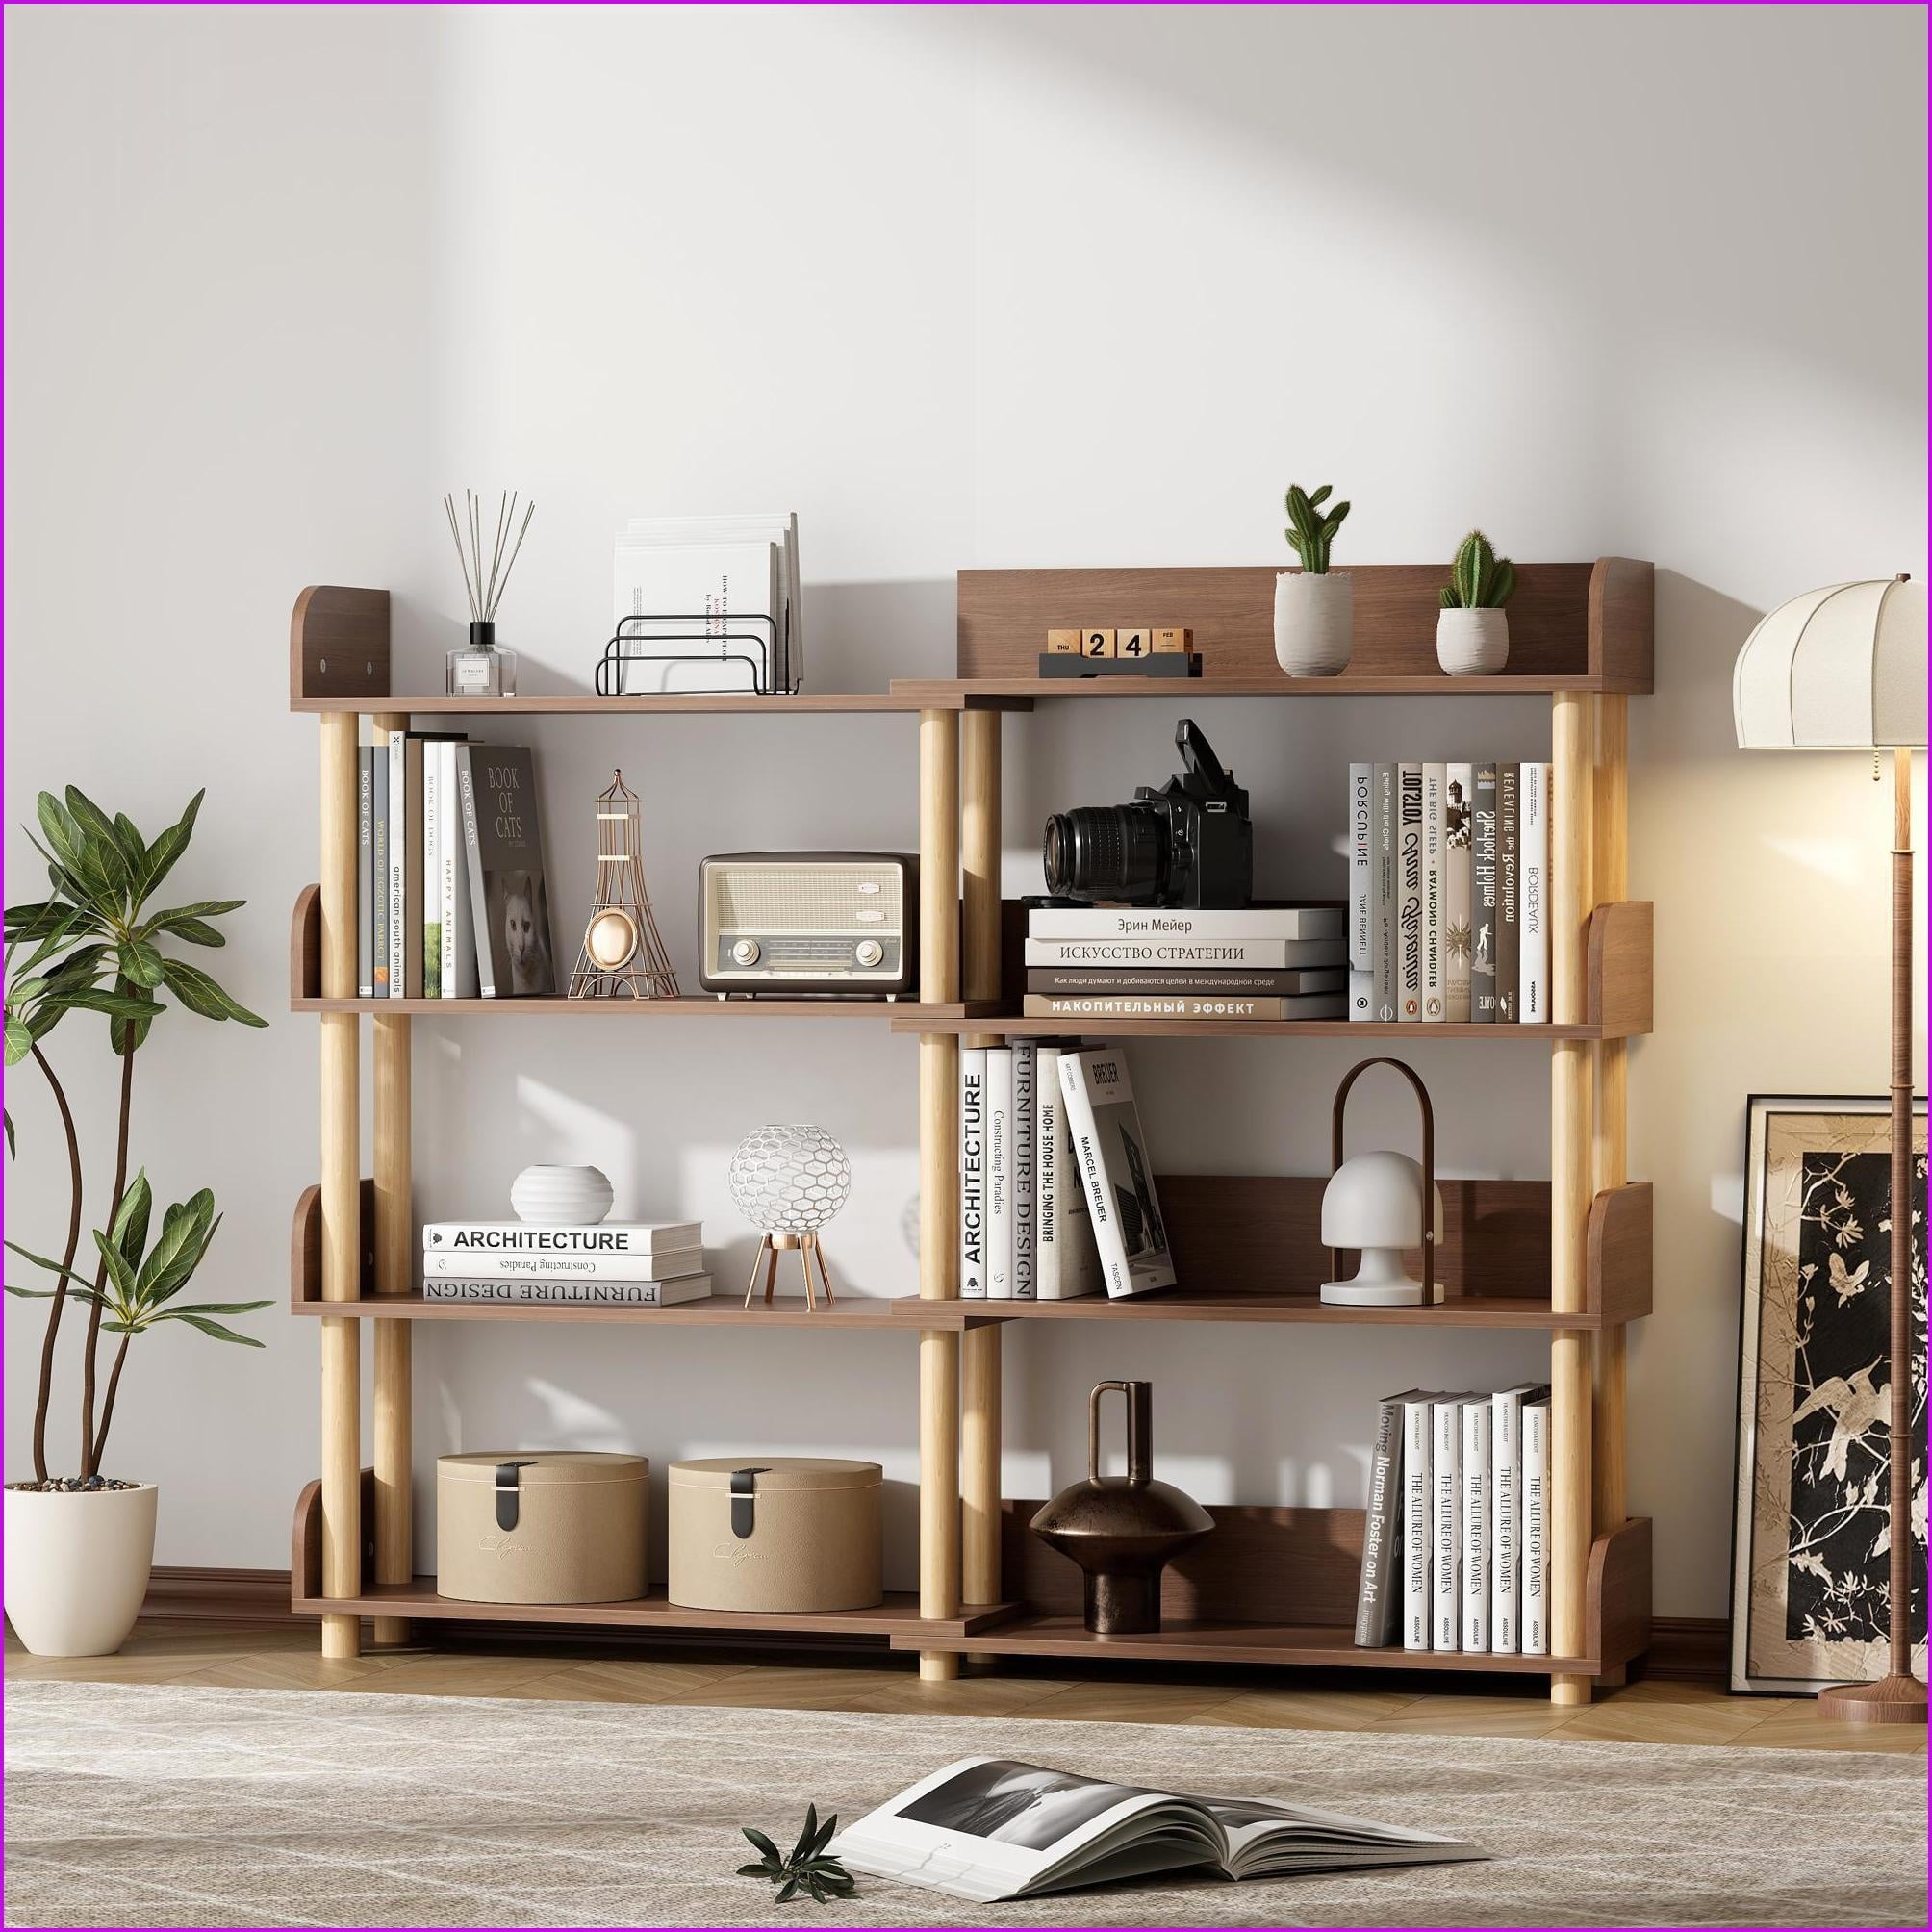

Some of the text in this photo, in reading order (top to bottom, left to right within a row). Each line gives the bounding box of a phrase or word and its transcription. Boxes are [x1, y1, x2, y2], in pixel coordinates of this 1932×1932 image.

[722, 597, 727, 607] TO
[1089, 633, 1105, 656] 2
[1126, 635, 1141, 656] 4
[488, 767, 520, 789] BOOK
[361, 770, 369, 847] BOOK OF CATS
[462, 770, 476, 846] BOOK OF CATS
[499, 792, 513, 813] OF
[496, 816, 522, 838] CATS
[377, 859, 385, 872] OF
[1118, 918, 1192, 934] Эрин Мейер
[1060, 947, 1245, 960] ИСКУССТВО СТРАТЕГИИ
[1123, 977, 1165, 985] добиваются
[1165, 978, 1187, 986] целей
[1052, 1000, 1254, 1015] НАКОПИТЕЛЬНЫЙ ЭФФЕКТ
[1092, 1062, 1120, 1085] BREUER
[965, 1074, 980, 1264] ARCHITECTURE
[992, 1110, 1004, 1215] Constructing Paradies
[1017, 1046, 1030, 1295] FURNITURE DESIGN
[1042, 1104, 1053, 1242] BRINGING THE HOUSE HOME
[1080, 1136, 1107, 1223] MARCEL BREUER
[454, 1231, 629, 1250] ARCHITECTURE
[499, 1259, 596, 1273] Constructing Paradies
[427, 1283, 657, 1302] FURNITURE DESIGN
[1363, 1404, 1395, 1603] Moving Norman Foster on Art
[1411, 1472, 1422, 1593] THE ALLURE OF WOMEN
[1440, 1474, 1451, 1594] THE ALLURE OF WOMEN
[1470, 1474, 1481, 1595] THE ALLURE OF WOMEN
[1500, 1466, 1511, 1593] THE ALLURE OF WOMEN
[1530, 1476, 1540, 1597] THE ALLURE OF WOMEN
